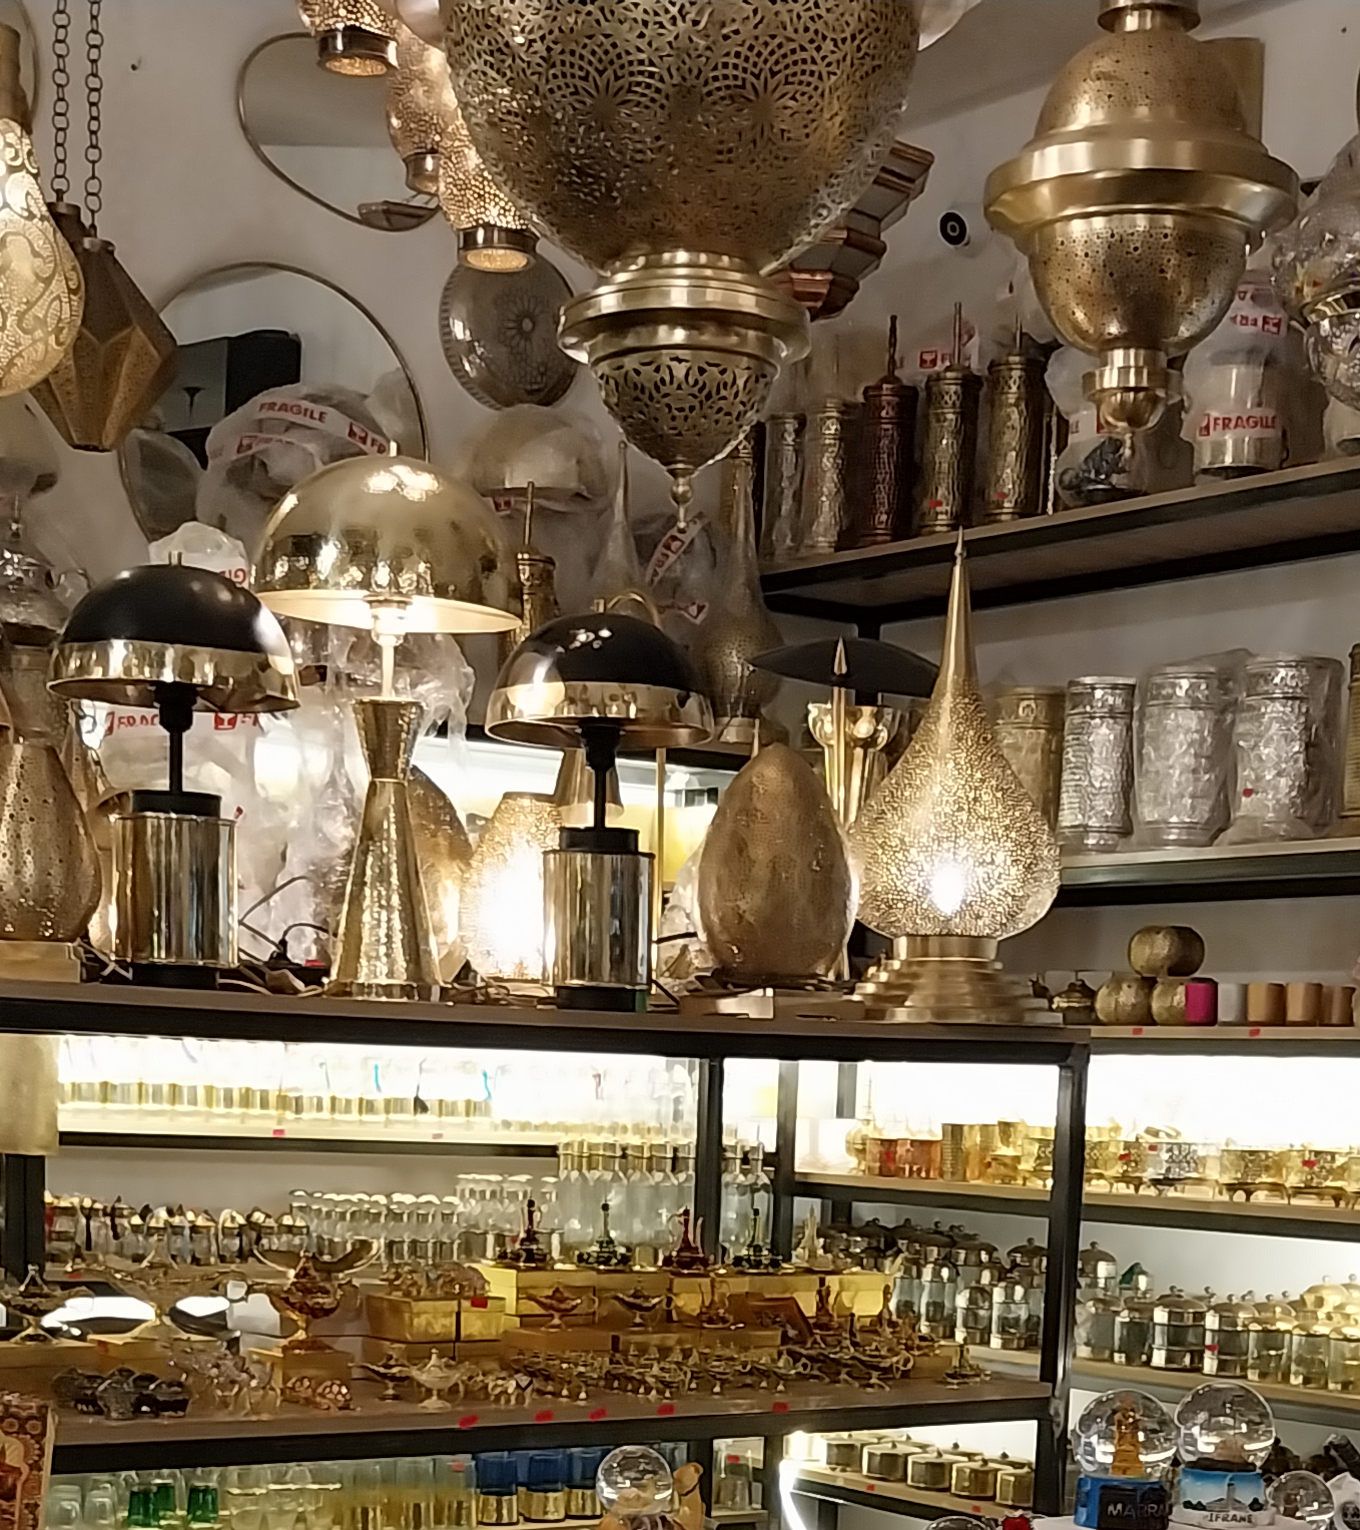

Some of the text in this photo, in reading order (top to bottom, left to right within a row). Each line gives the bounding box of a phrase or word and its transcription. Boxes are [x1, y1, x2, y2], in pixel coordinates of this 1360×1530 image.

[258, 401, 328, 424] FRAGILE
[1213, 415, 1277, 432] FRAGILE
[1208, 1512, 1253, 1523] IFRANE
